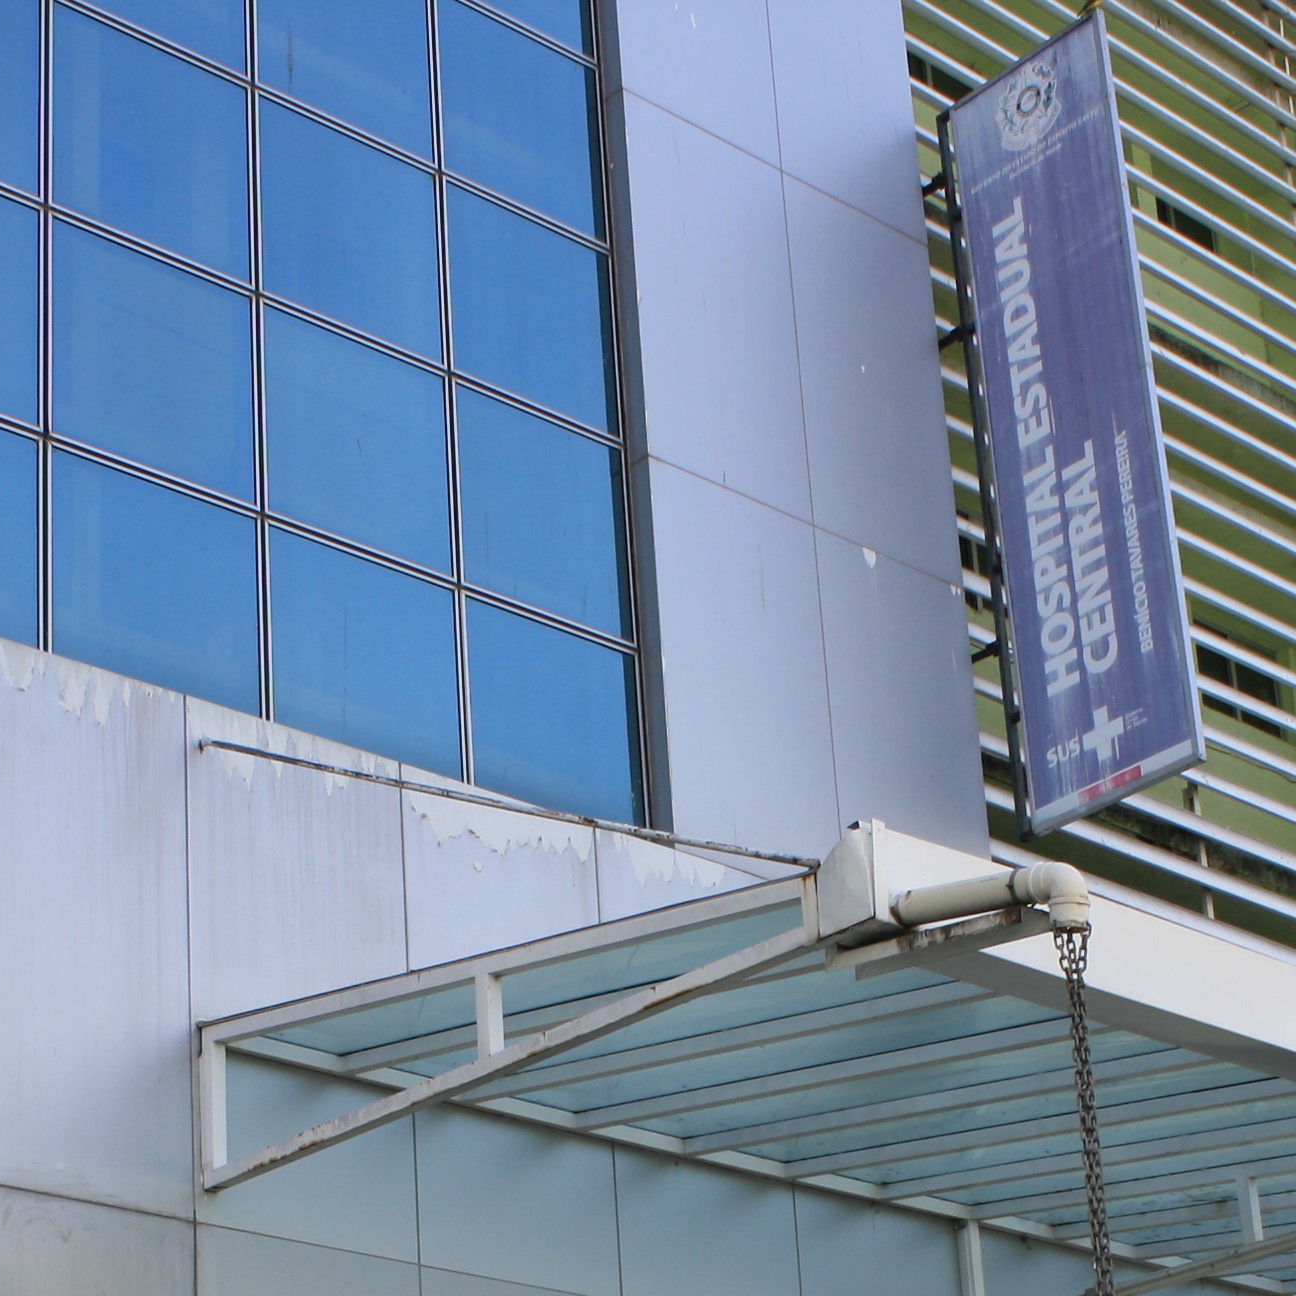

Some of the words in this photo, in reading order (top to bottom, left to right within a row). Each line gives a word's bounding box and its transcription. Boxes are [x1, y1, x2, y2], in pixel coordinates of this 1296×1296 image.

[992, 196, 1051, 450] ESTADUAL
[1114, 430, 1135, 504] PEREIRA
[1023, 445, 1081, 698] HOSPITAL
[1061, 439, 1119, 676] CENTRAL
[1121, 503, 1145, 584] TAVARES
[1133, 581, 1154, 655] BENÍCIO
[1046, 734, 1082, 769] SUS
